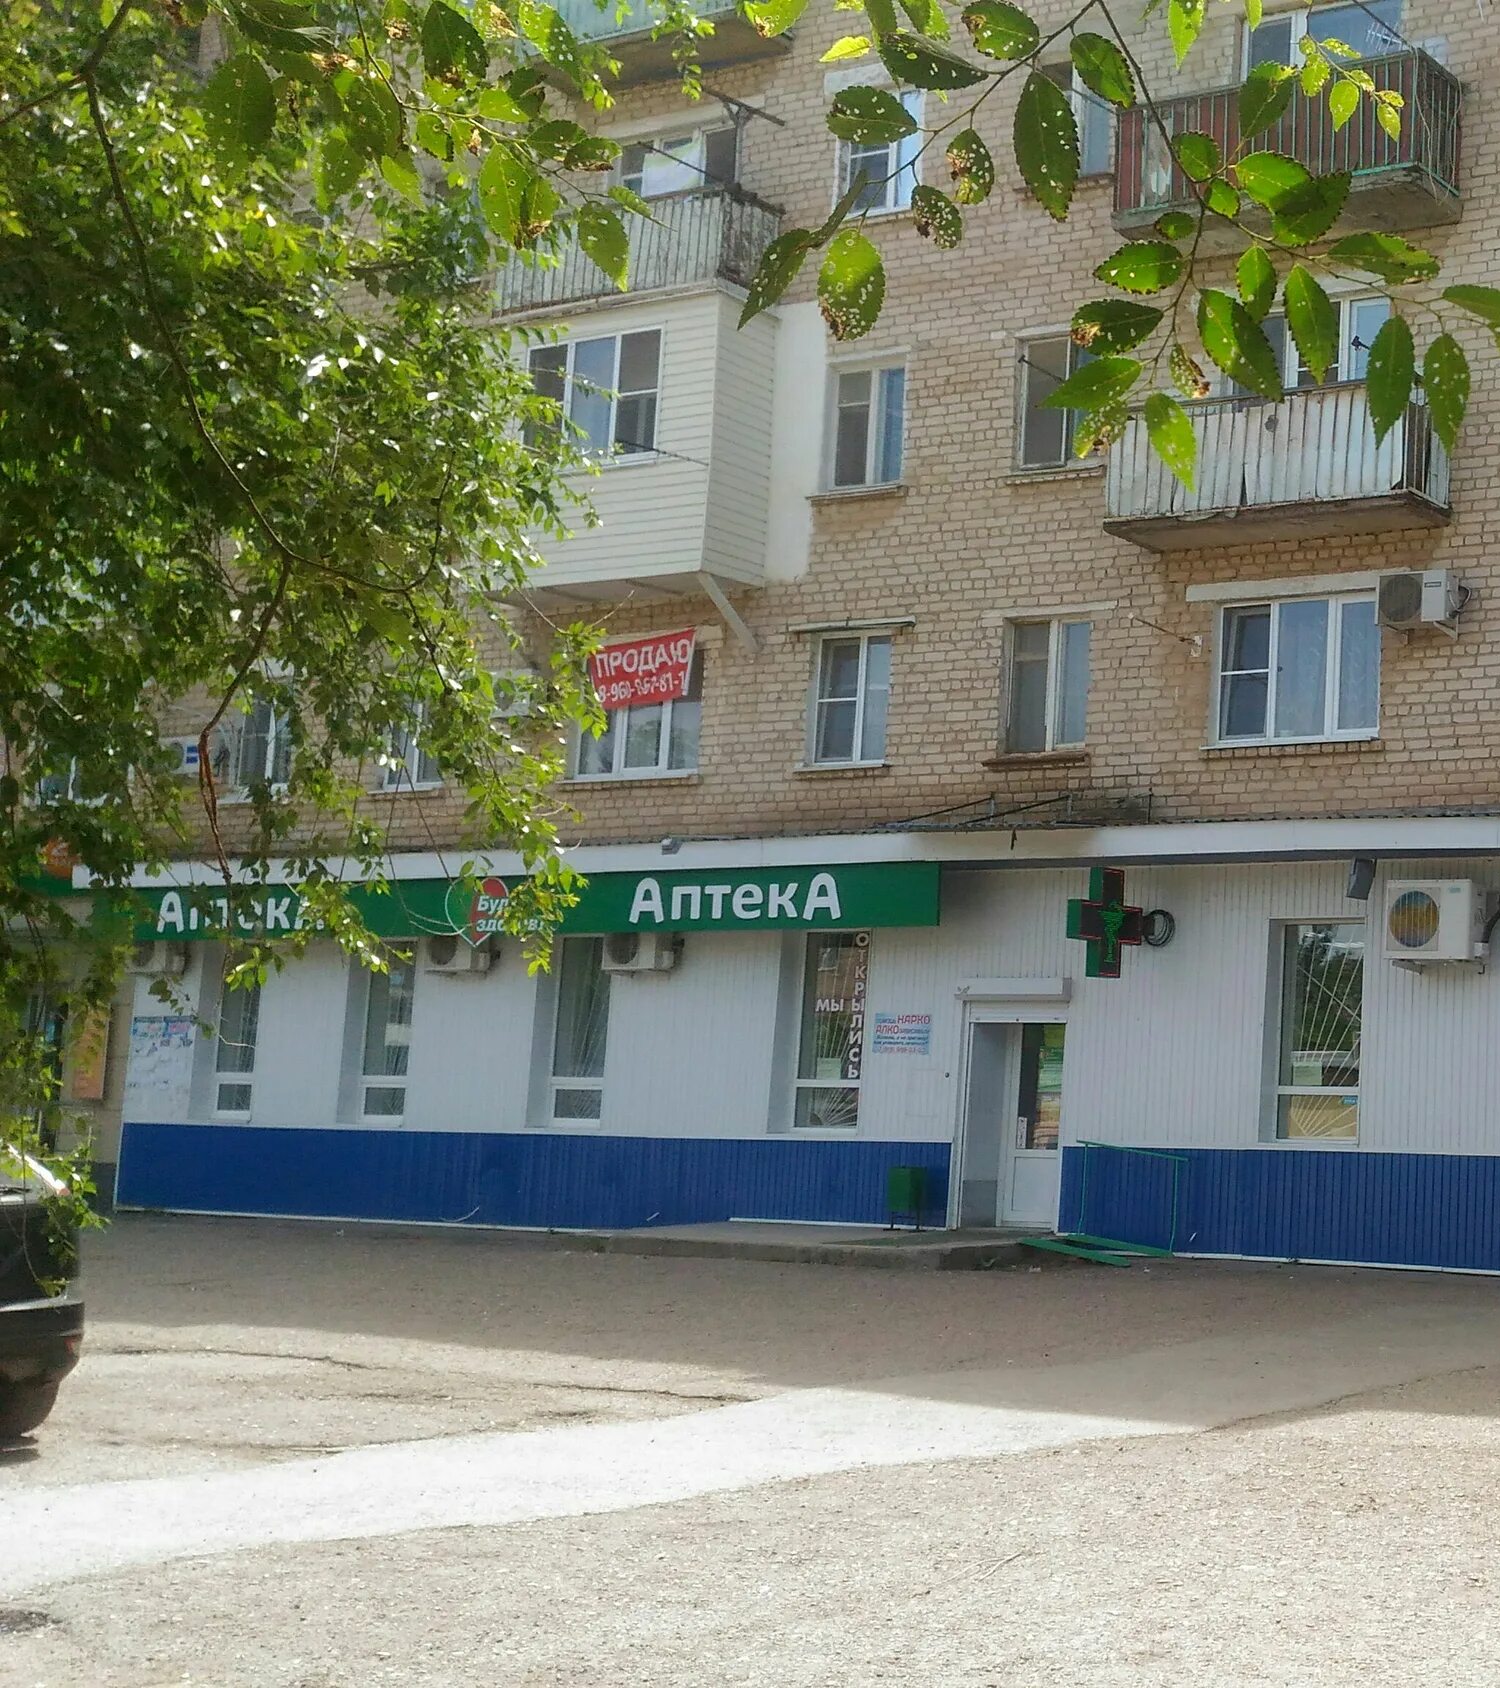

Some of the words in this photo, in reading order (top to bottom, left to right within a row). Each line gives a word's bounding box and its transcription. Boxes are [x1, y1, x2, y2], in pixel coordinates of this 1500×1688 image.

[595, 639, 690, 678] ПРОДАЮ
[477, 895, 512, 914] Буд
[629, 873, 841, 923] АптекА
[815, 999, 844, 1012] МЫ
[847, 933, 870, 1078] ОТКРЫЛИСЬ
